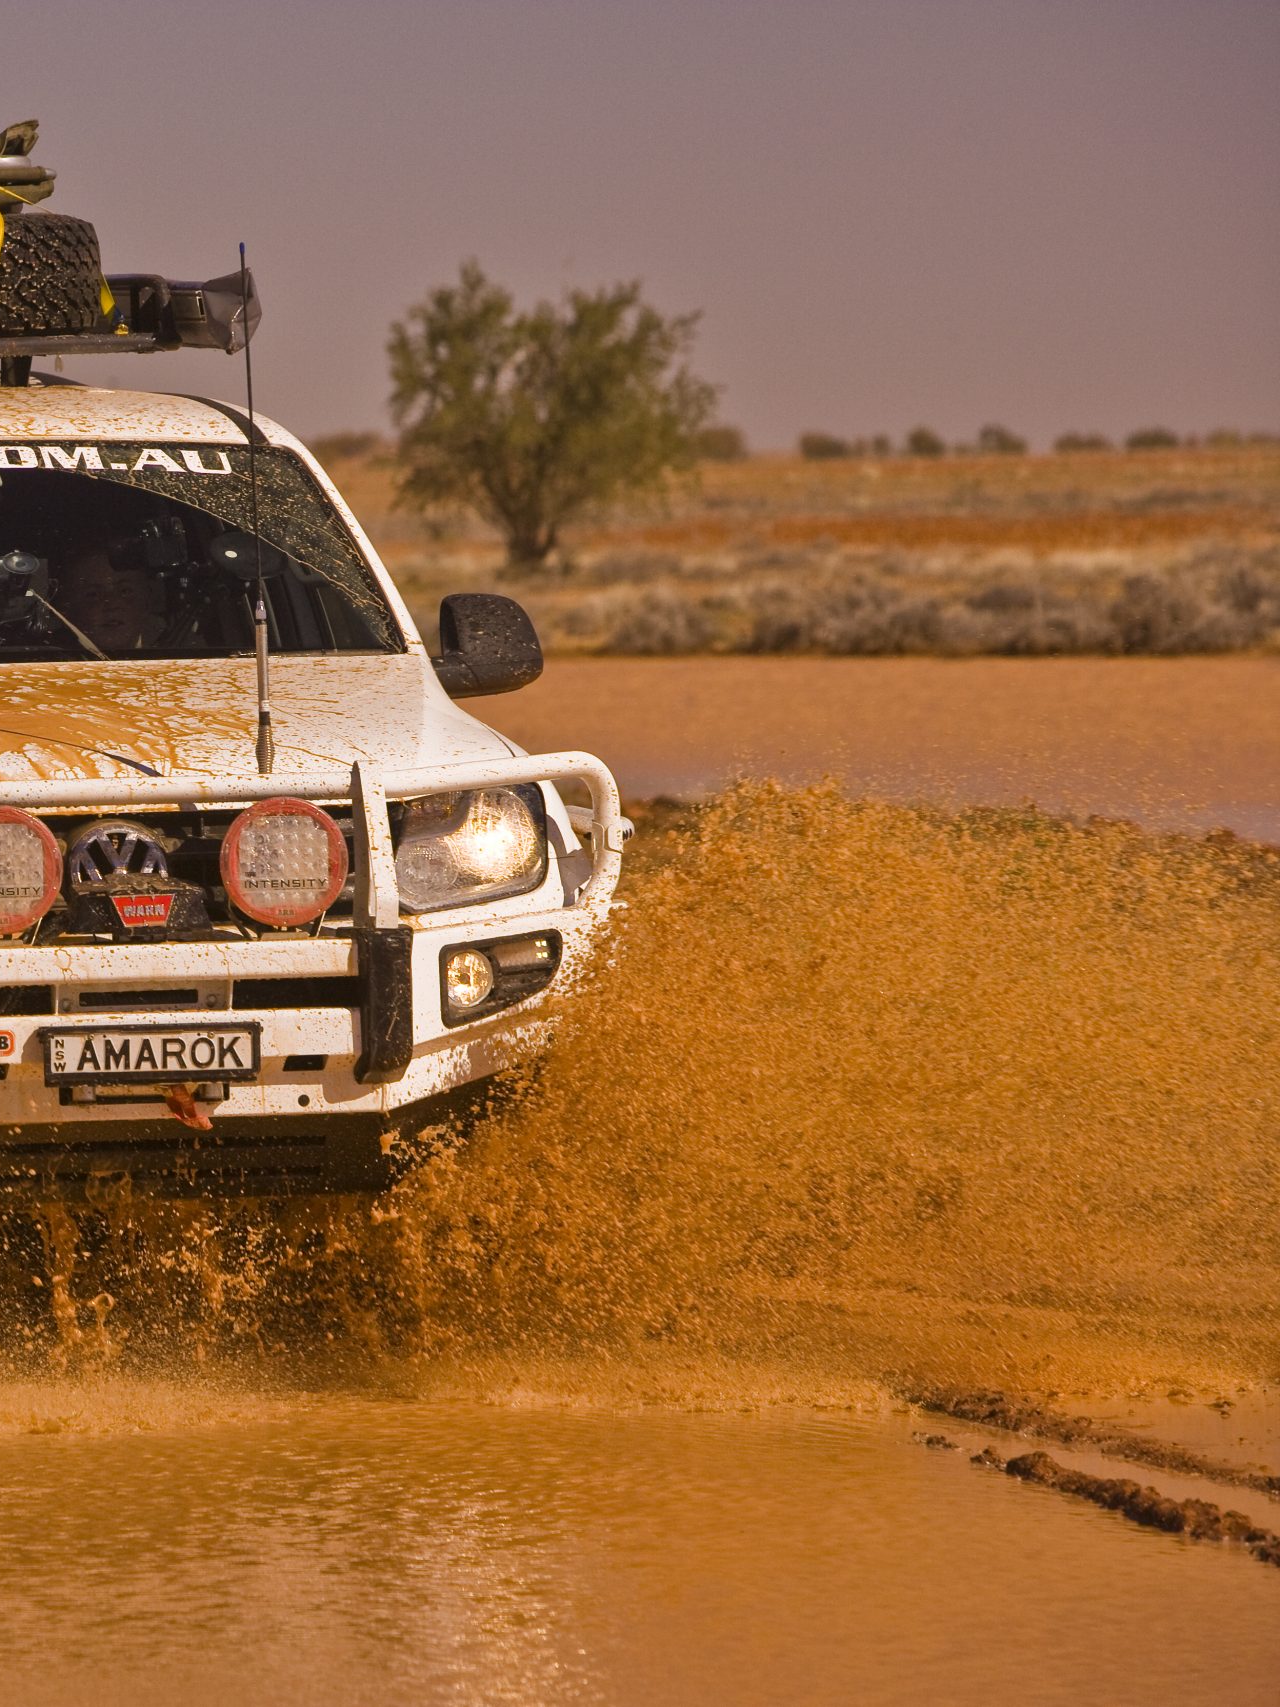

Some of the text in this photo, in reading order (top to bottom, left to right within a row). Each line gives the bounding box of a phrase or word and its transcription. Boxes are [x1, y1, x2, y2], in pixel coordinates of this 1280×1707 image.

[244, 877, 327, 889] INTENSITY
[123, 903, 165, 917] WARN
[77, 1036, 243, 1071] AMAROK
